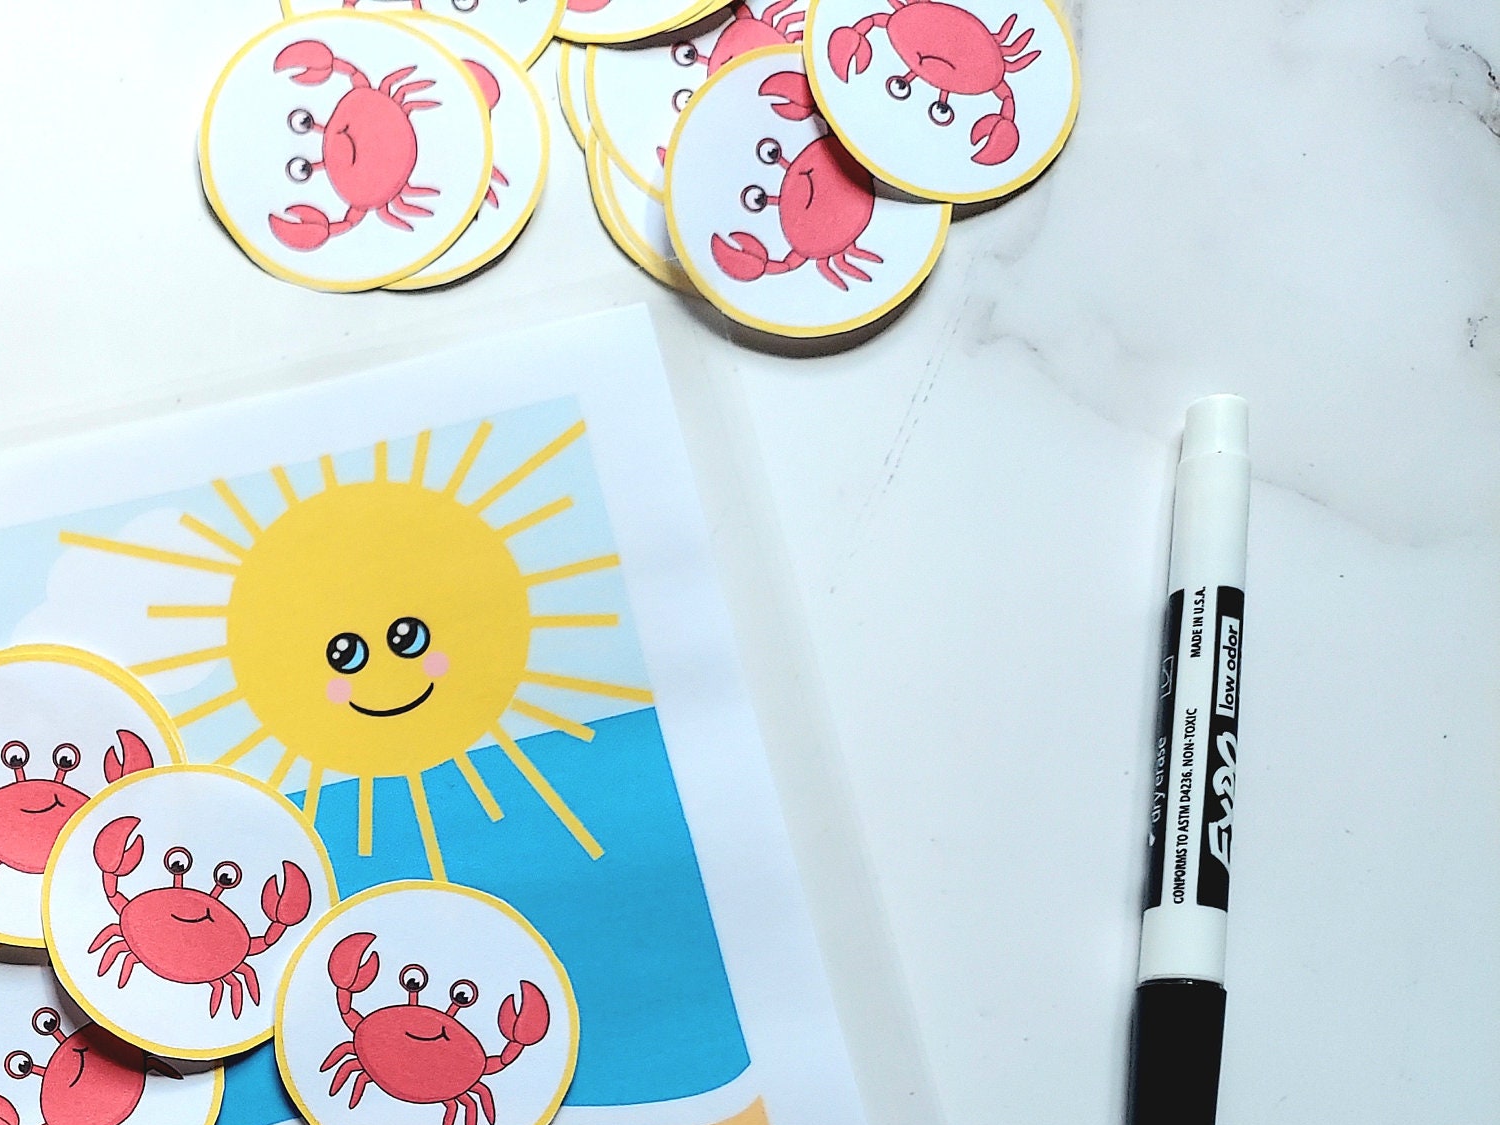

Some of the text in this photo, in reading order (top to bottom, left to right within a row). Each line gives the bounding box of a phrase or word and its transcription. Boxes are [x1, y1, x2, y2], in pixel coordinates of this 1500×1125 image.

[1190, 586, 1206, 658] MADE IN U.S.A.
[1219, 625, 1238, 711] low odor
[1172, 708, 1197, 904] CONFORMS TO ASTM D4236. NON-TOXIC
